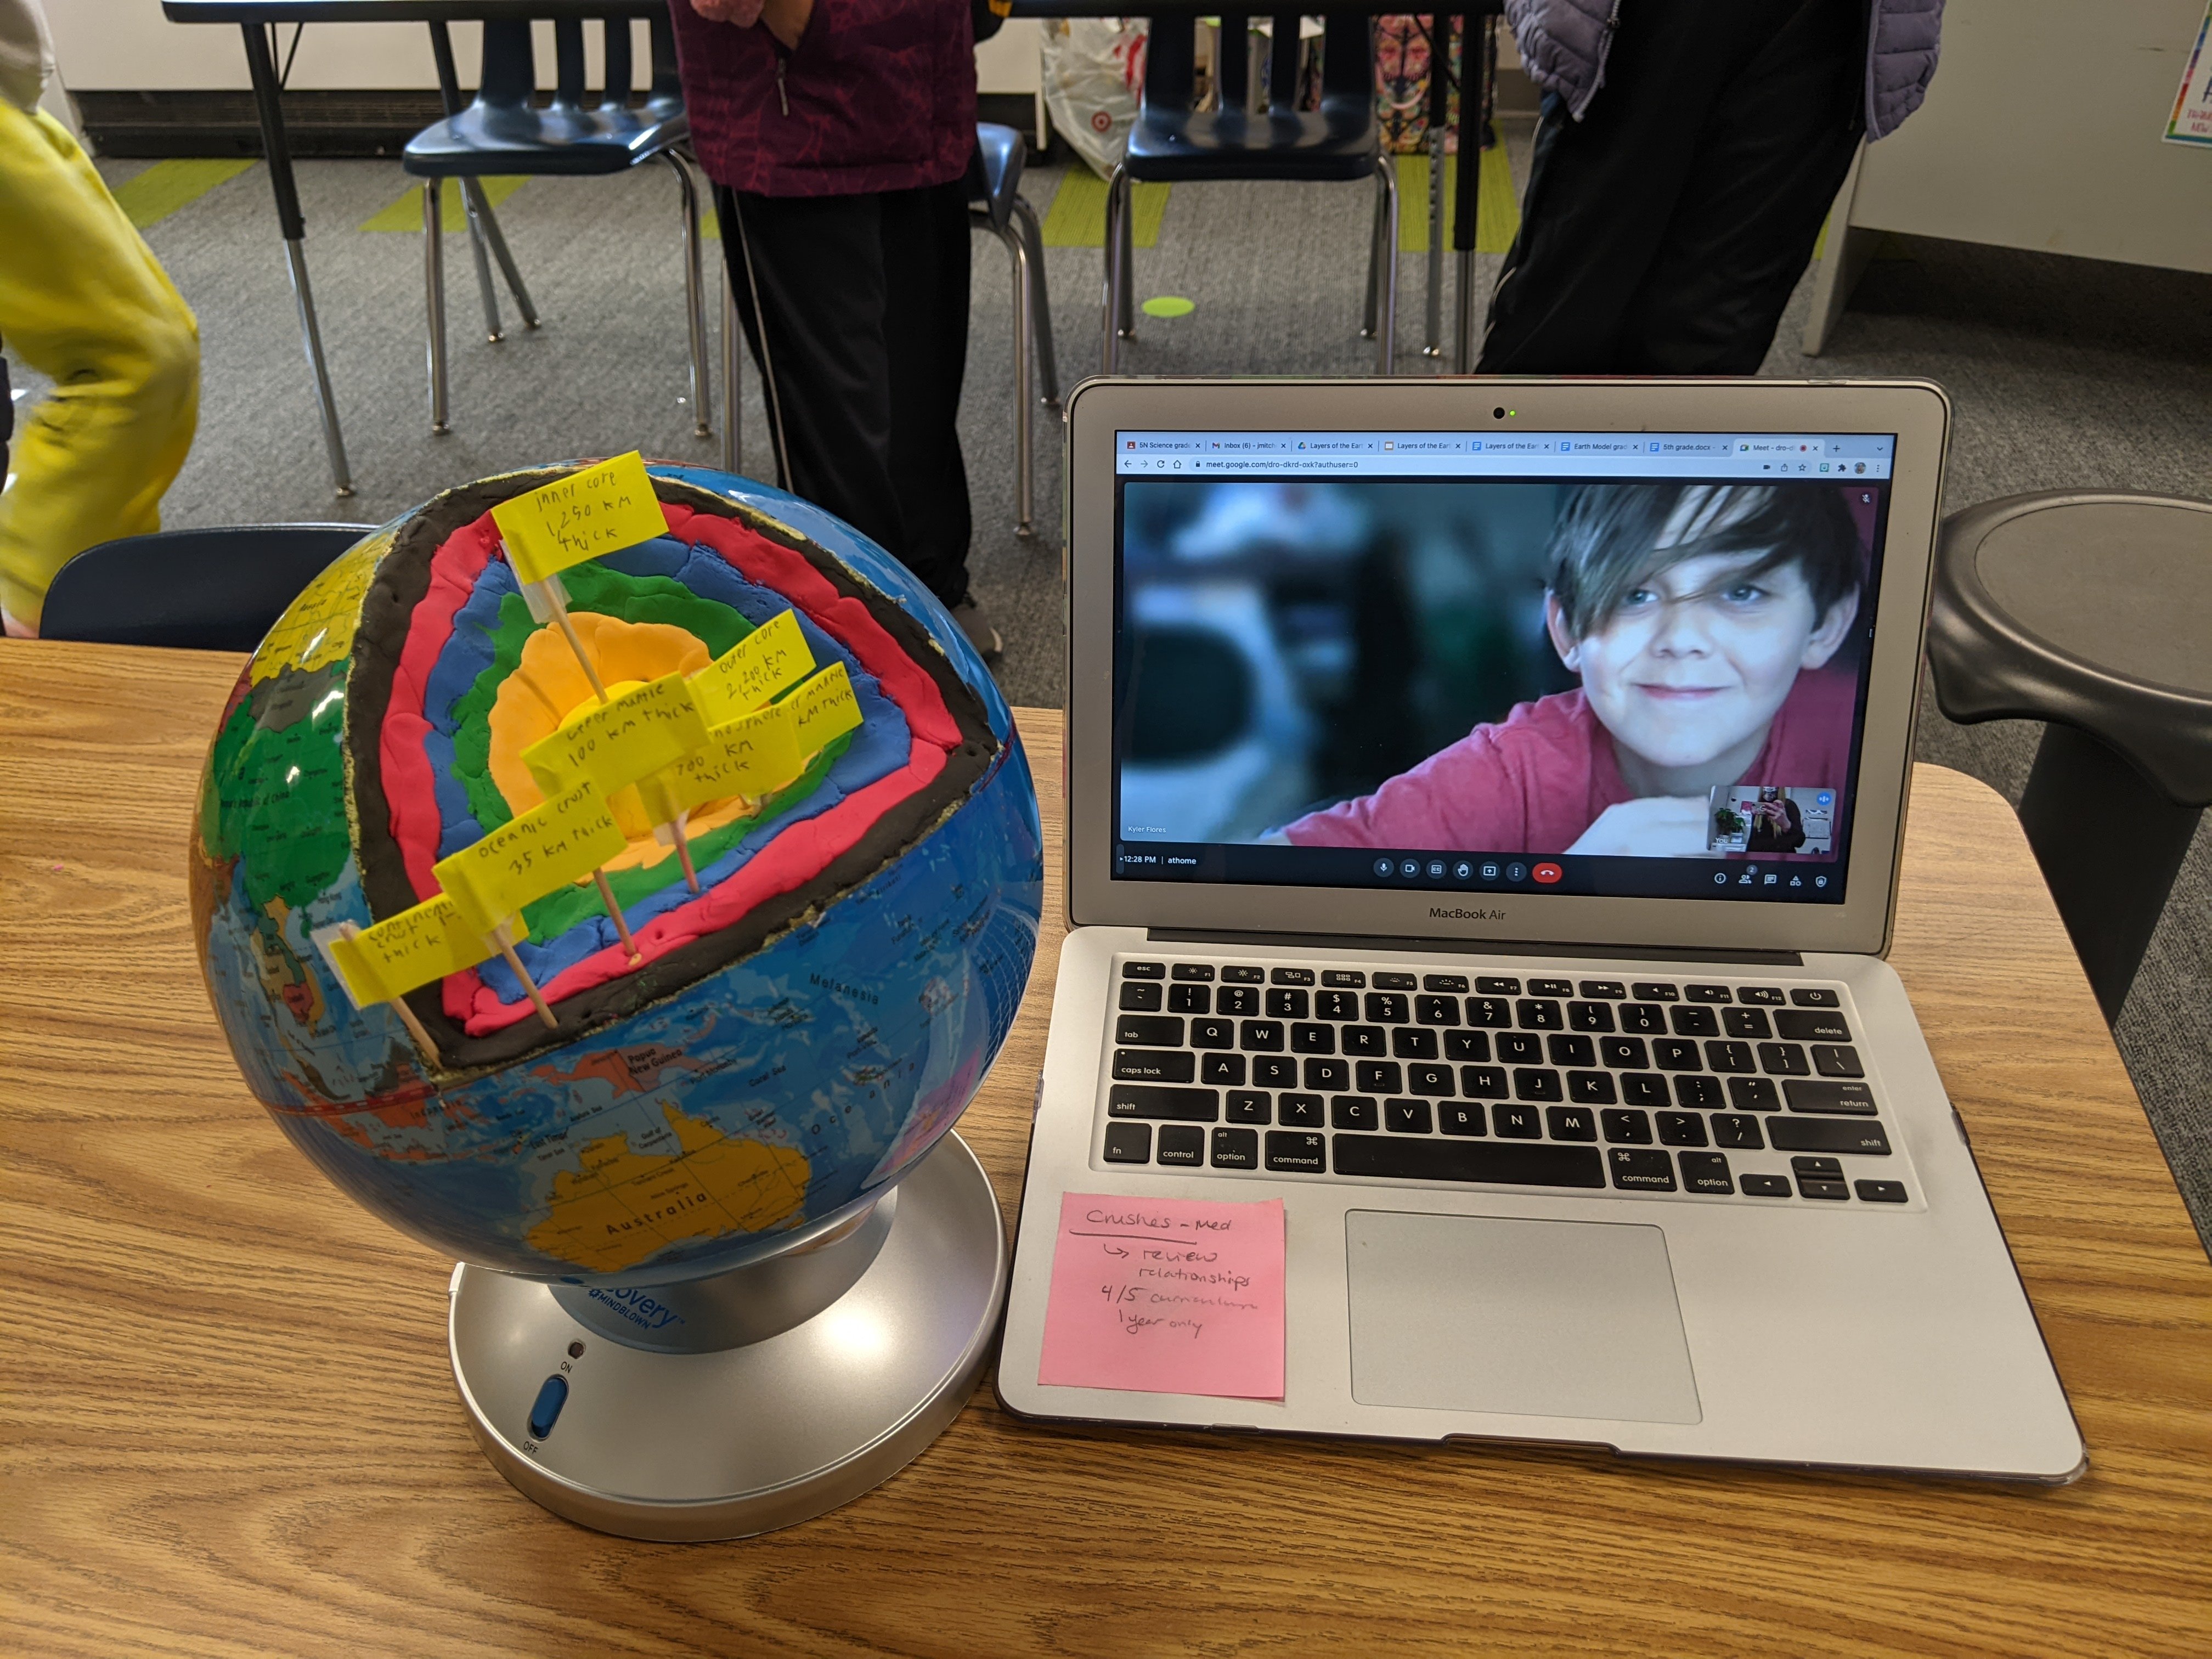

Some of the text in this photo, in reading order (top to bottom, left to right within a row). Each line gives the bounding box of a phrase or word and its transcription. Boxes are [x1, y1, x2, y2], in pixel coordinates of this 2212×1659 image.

[1206, 461, 1358, 469] meet.google.com/dro-dkrd-oxk?authuser=0
[534, 471, 616, 512] inner core
[720, 620, 780, 673] outer core
[568, 739, 595, 767] 100
[509, 851, 532, 875] 35
[1429, 907, 1506, 921] MacBook Air
[809, 973, 879, 1005] Melanesia
[1187, 998, 1191, 1007] 1
[1234, 1001, 1242, 1009] 2
[1284, 1003, 1291, 1011] 3
[1333, 1005, 1341, 1013] 4
[1384, 1008, 1391, 1016] 5
[1435, 1009, 1442, 1018] 6
[1485, 1012, 1493, 1020] 7
[1537, 1014, 1545, 1023] 8
[1588, 1017, 1596, 1025] 9
[1206, 1027, 1218, 1036] Q
[1255, 1029, 1269, 1039] W
[1309, 1032, 1316, 1041] E
[1359, 1035, 1368, 1044] R
[1410, 1037, 1419, 1046] T
[1462, 1039, 1471, 1049] Y
[1514, 1042, 1525, 1052] U
[628, 1048, 656, 1064] Papua
[651, 1048, 683, 1066] Guinea
[1672, 1048, 1681, 1058] P
[772, 1065, 787, 1076] Sea
[1218, 1063, 1229, 1073] A
[1271, 1065, 1279, 1075] S
[1322, 1068, 1332, 1077] D
[1375, 1070, 1383, 1080] F
[1426, 1073, 1437, 1083] G
[1479, 1076, 1491, 1086] H
[1535, 1079, 1542, 1088] J
[1587, 1081, 1598, 1091] K
[1641, 1083, 1651, 1093] L
[1244, 1101, 1254, 1111] Z
[1296, 1103, 1307, 1114] X
[1350, 1106, 1360, 1116] C
[1403, 1109, 1413, 1119] V
[1458, 1112, 1468, 1122] B
[1511, 1115, 1523, 1125] N
[1566, 1118, 1580, 1128] M
[1217, 1151, 1245, 1161] option
[1273, 1156, 1318, 1165] command
[1697, 1178, 1728, 1187] option
[606, 1192, 708, 1235] Australia
[1086, 1210, 1171, 1229] Crushes
[1143, 1249, 1217, 1262] review
[1139, 1268, 1250, 1291] relationships
[1102, 1284, 1148, 1304] 4/5
[606, 1289, 679, 1329] overy
[1126, 1313, 1164, 1334] year
[1169, 1319, 1203, 1339] only
[560, 1361, 573, 1374] ON
[523, 1441, 539, 1454] OFF
